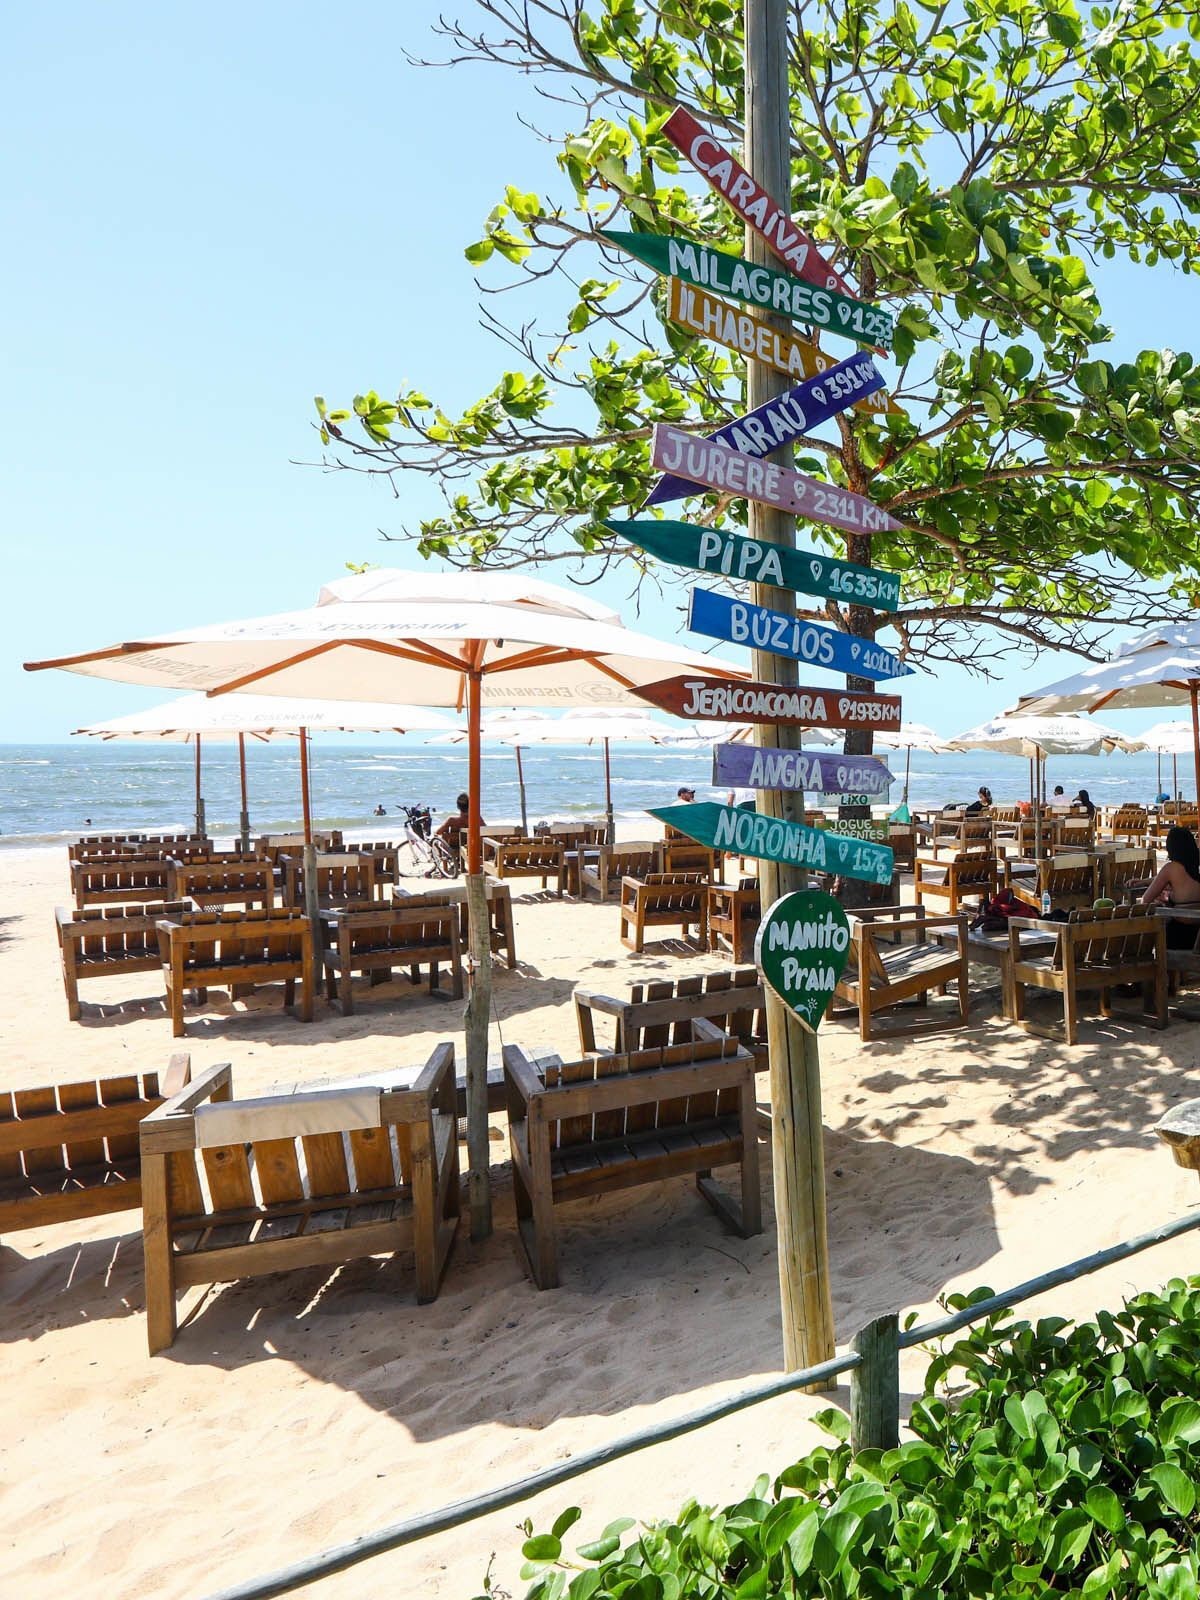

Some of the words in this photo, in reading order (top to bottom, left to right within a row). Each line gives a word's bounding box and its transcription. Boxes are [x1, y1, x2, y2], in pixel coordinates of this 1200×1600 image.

[852, 307, 894, 340] 1253
[716, 391, 807, 455] ARAÚ
[814, 489, 859, 524] 2311
[862, 503, 889, 531] KM
[748, 750, 823, 790] ANGRA
[713, 808, 826, 866] NORONHA
